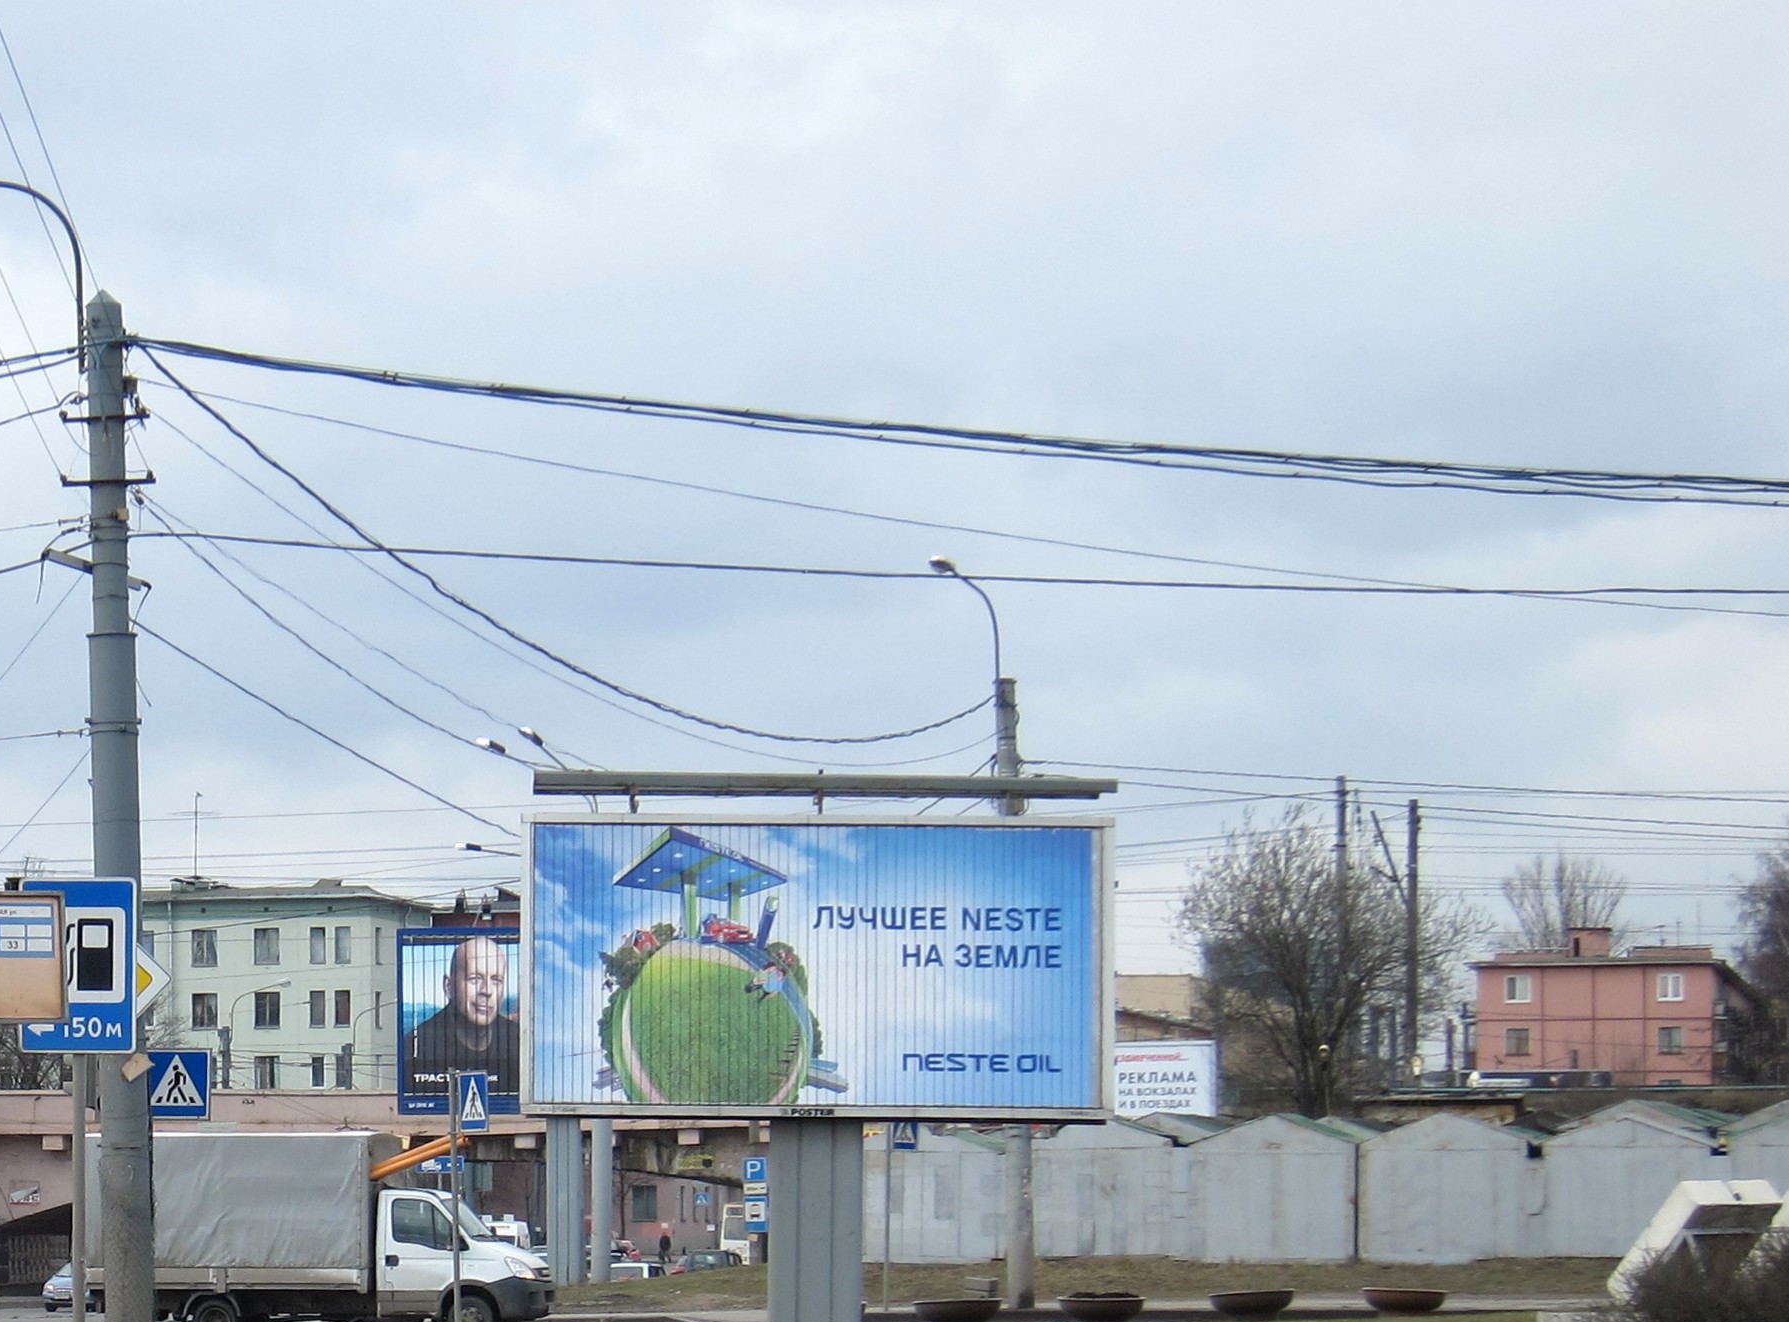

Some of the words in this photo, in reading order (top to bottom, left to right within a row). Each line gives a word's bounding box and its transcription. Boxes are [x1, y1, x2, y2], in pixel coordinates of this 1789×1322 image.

[812, 905, 947, 930] ЛУЧШЕЕ
[962, 907, 1062, 932] NESTE
[7, 941, 19, 950] 33
[902, 943, 944, 968] НА
[955, 944, 1062, 968] ЗЕМЛЕ
[903, 1053, 1010, 1073] NESTE
[1017, 1054, 1062, 1073] OIL
[1119, 1071, 1197, 1084] РЕКЛАМА
[1137, 1087, 1196, 1096] ВОКЗАЛАХ
[1139, 1100, 1191, 1109] ПОЕЗДАХ
[746, 1161, 761, 1179] P
